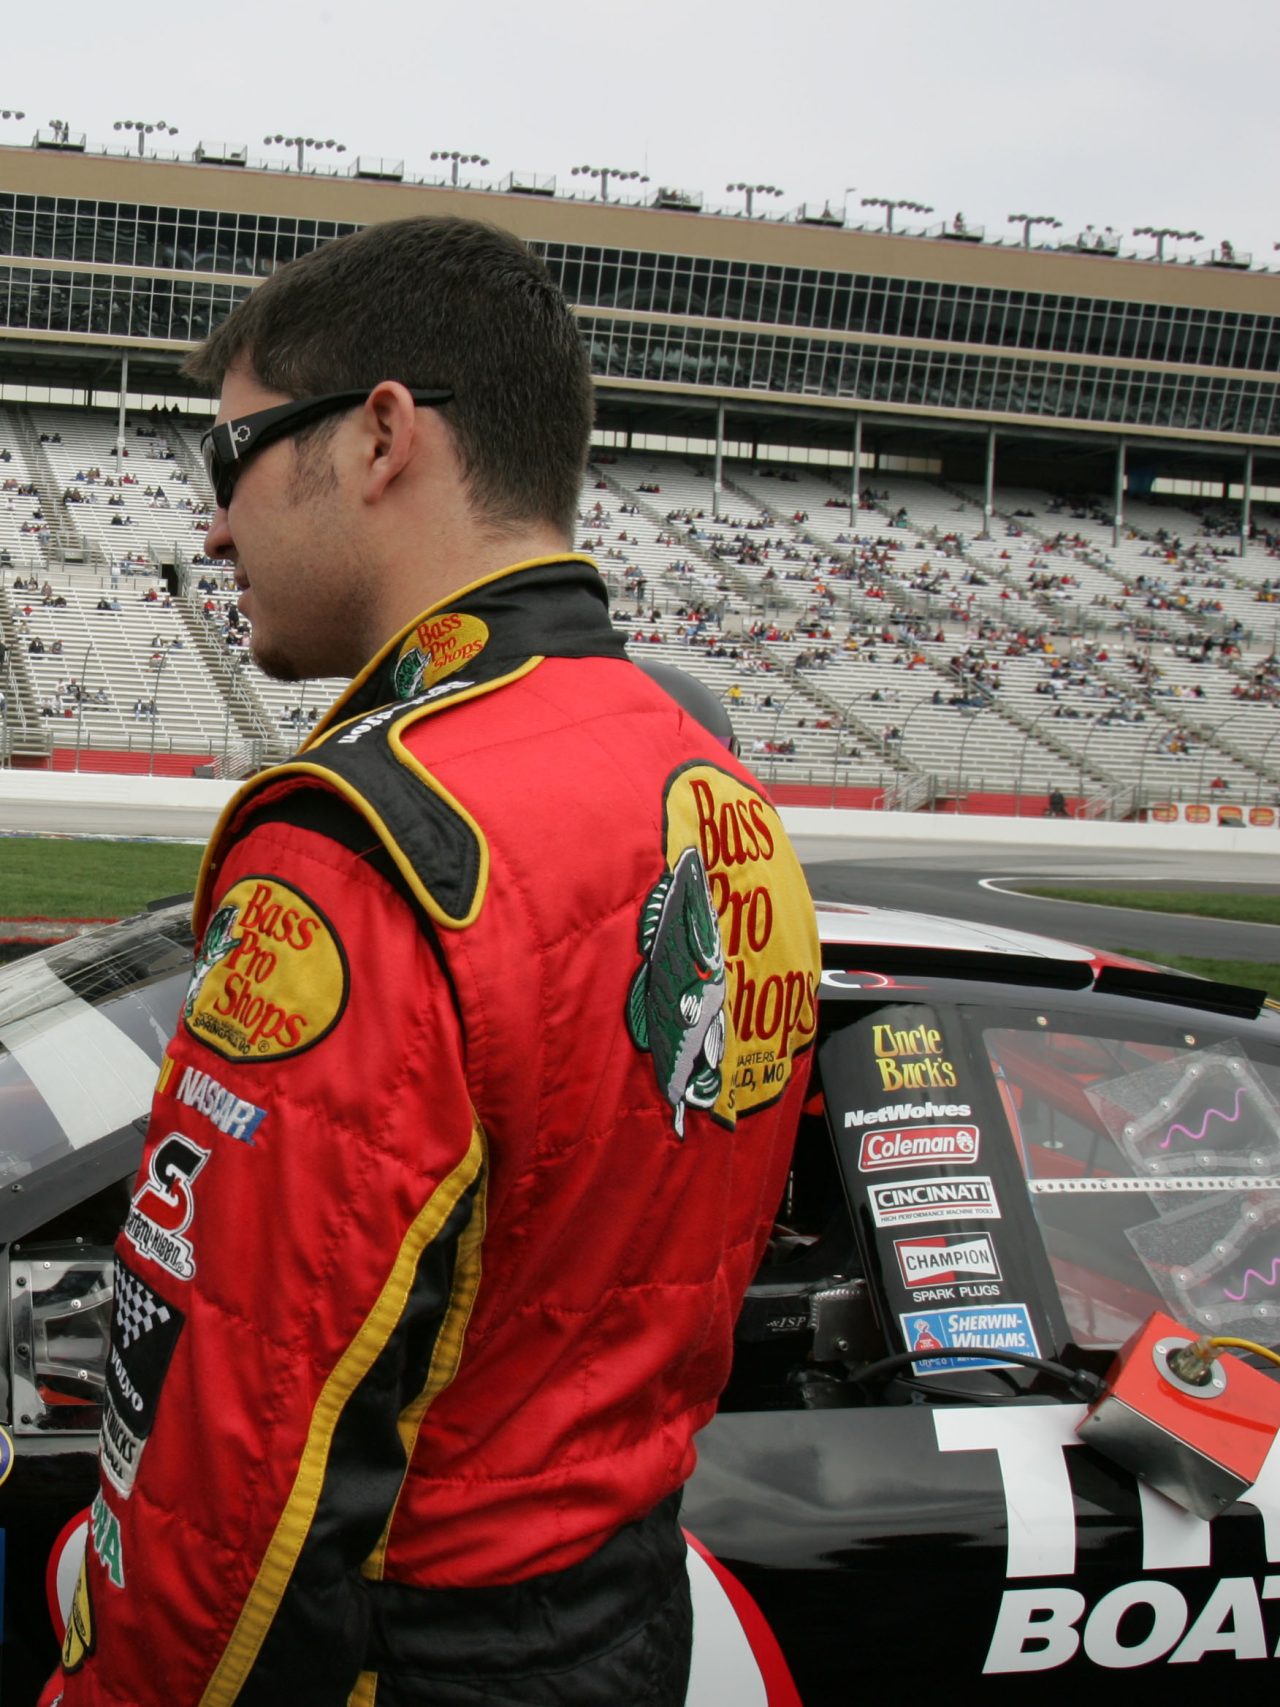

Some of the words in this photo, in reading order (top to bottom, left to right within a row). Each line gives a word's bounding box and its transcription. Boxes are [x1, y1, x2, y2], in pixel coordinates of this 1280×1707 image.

[416, 613, 462, 648] Bass
[431, 637, 456, 662] Pro
[690, 779, 774, 872] Bass
[239, 884, 321, 950] Bass
[225, 930, 278, 984] Pro
[213, 972, 308, 1048] Shops
[724, 960, 817, 1060] hops
[872, 1024, 943, 1057] Uncle
[762, 1063, 785, 1085] MO
[876, 1058, 957, 1091] Buck's
[176, 1066, 257, 1140] NASCAR
[844, 1102, 971, 1128] NetWolves
[867, 1133, 955, 1160] Coleman
[878, 1184, 988, 1207] CINCINNATI
[906, 1249, 990, 1271] CHAMPION
[913, 1288, 955, 1302] SPARK
[959, 1285, 1000, 1297] PLUGS
[948, 1313, 1023, 1333] SHERWIN-
[951, 1332, 1026, 1349] WILLIAMS
[111, 1343, 144, 1412] VOLVO
